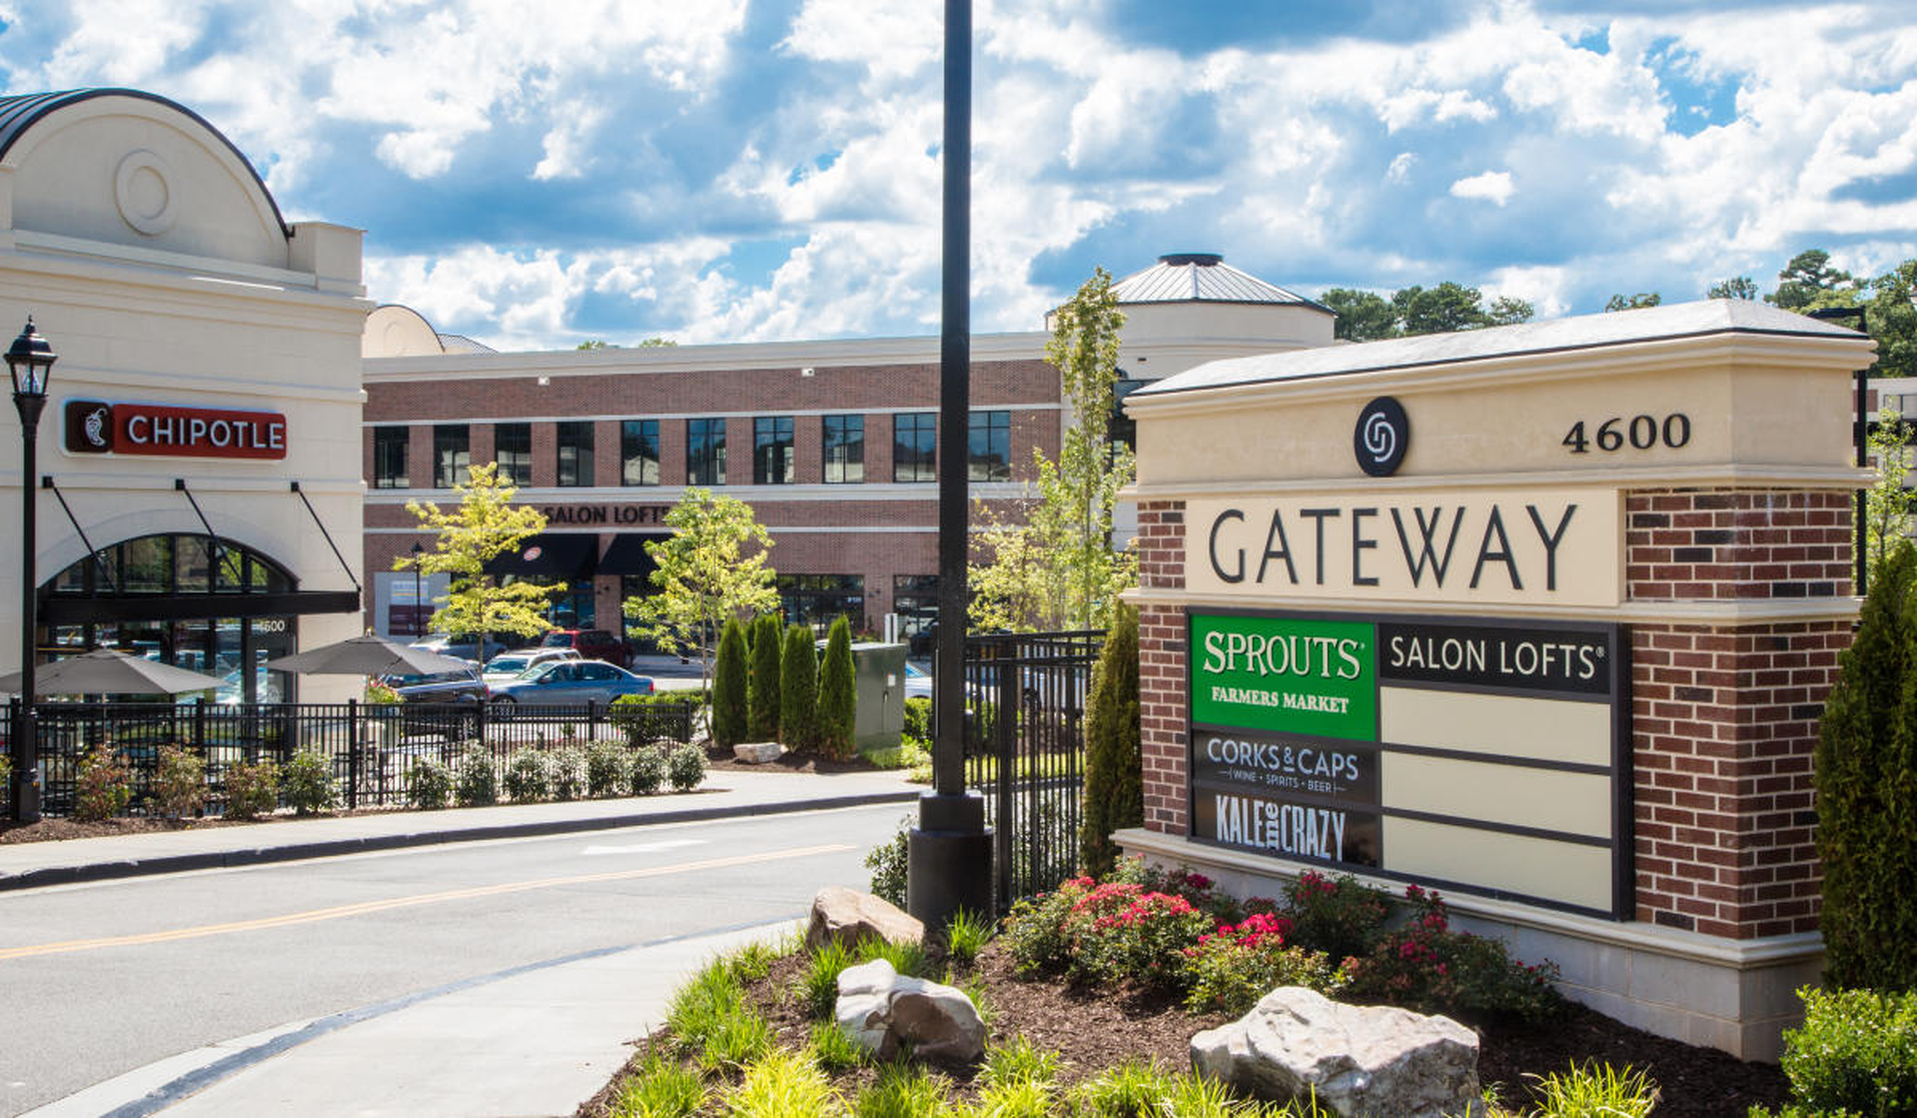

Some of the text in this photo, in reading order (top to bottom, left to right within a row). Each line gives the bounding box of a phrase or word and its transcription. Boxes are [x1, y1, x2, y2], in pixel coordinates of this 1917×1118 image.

[128, 415, 285, 450] CHIPOTLE
[1561, 413, 1692, 453] 4600
[544, 506, 606, 524] SALON
[1208, 503, 1578, 591] GATEWAY
[1391, 636, 1485, 672] SALON
[1211, 686, 1349, 714] FARMERS MARKET
[1207, 737, 1281, 771] CORKS
[1297, 748, 1359, 781] CAPS
[1233, 769, 1332, 793] WINE SPIRITS BEER
[1216, 794, 1265, 847] KALE
[1280, 804, 1346, 862] CRAZY
